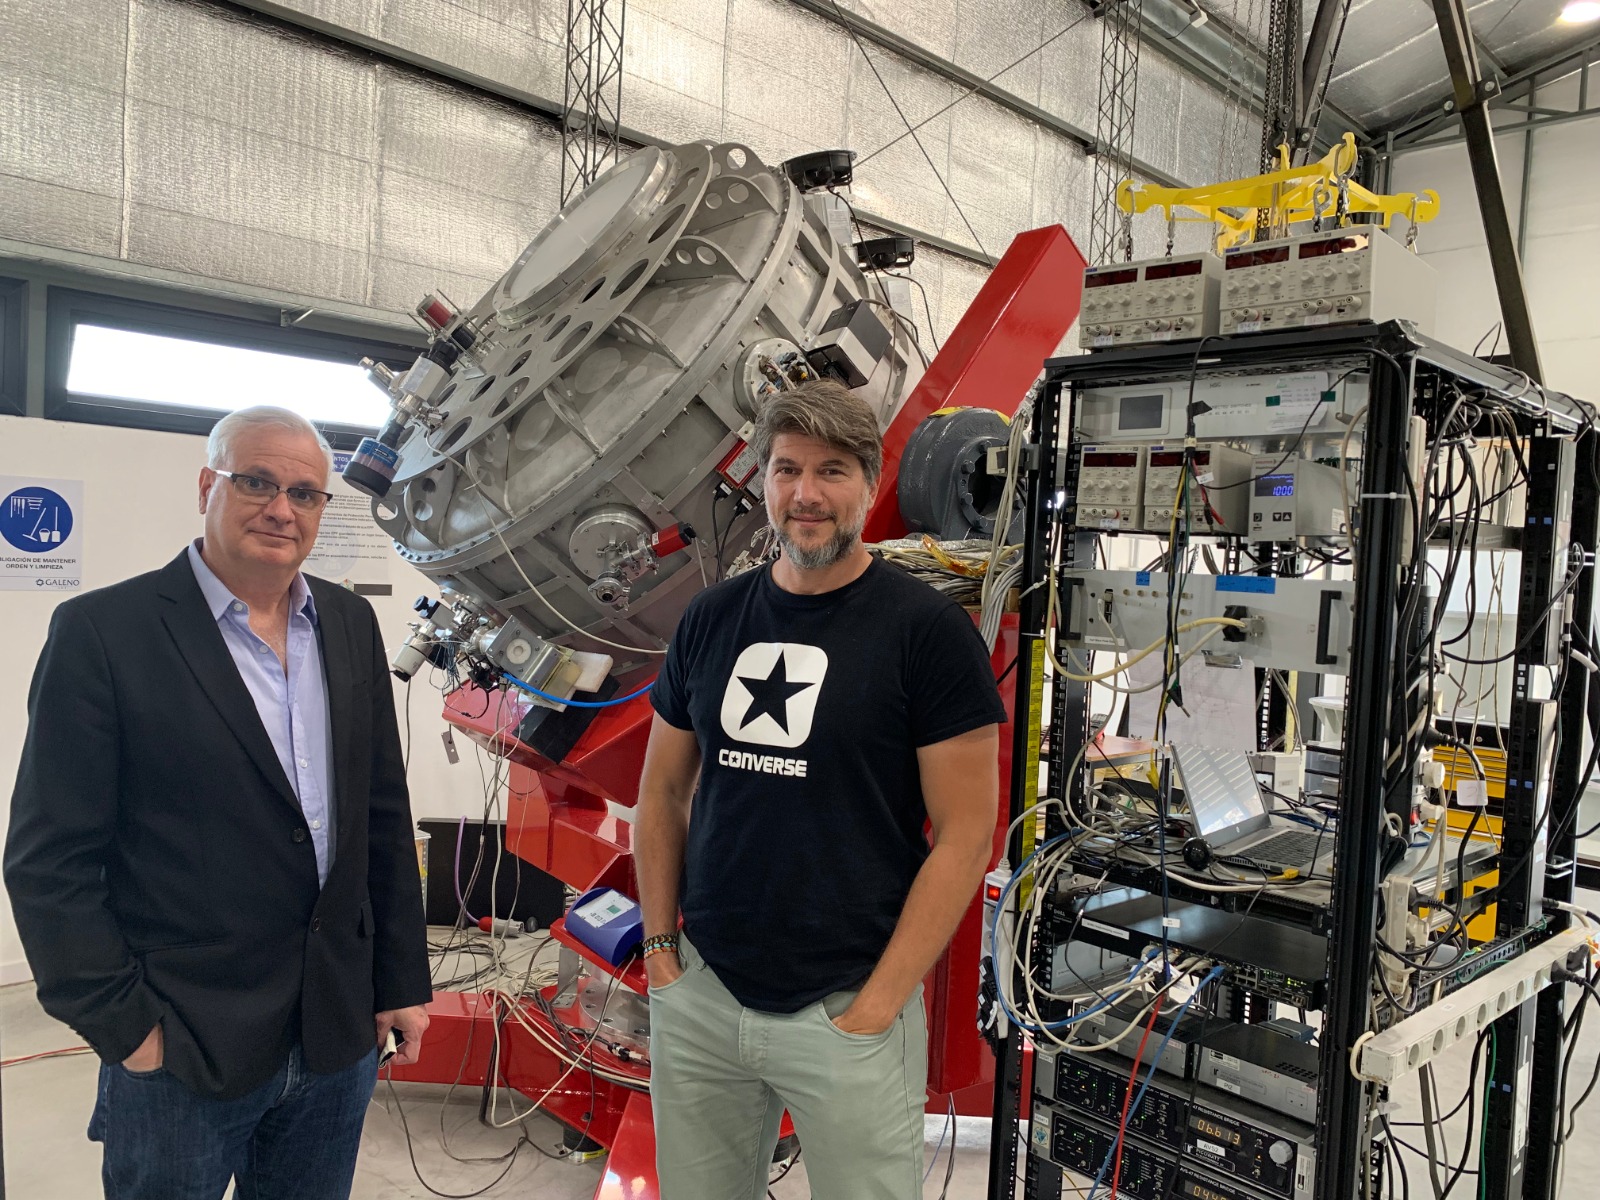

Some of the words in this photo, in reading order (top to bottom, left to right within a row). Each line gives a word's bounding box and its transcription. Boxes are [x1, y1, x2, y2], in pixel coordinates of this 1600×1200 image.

[1273, 486, 1293, 496] 1000
[45, 578, 80, 586] GALENO
[719, 748, 807, 778] CONVERSE
